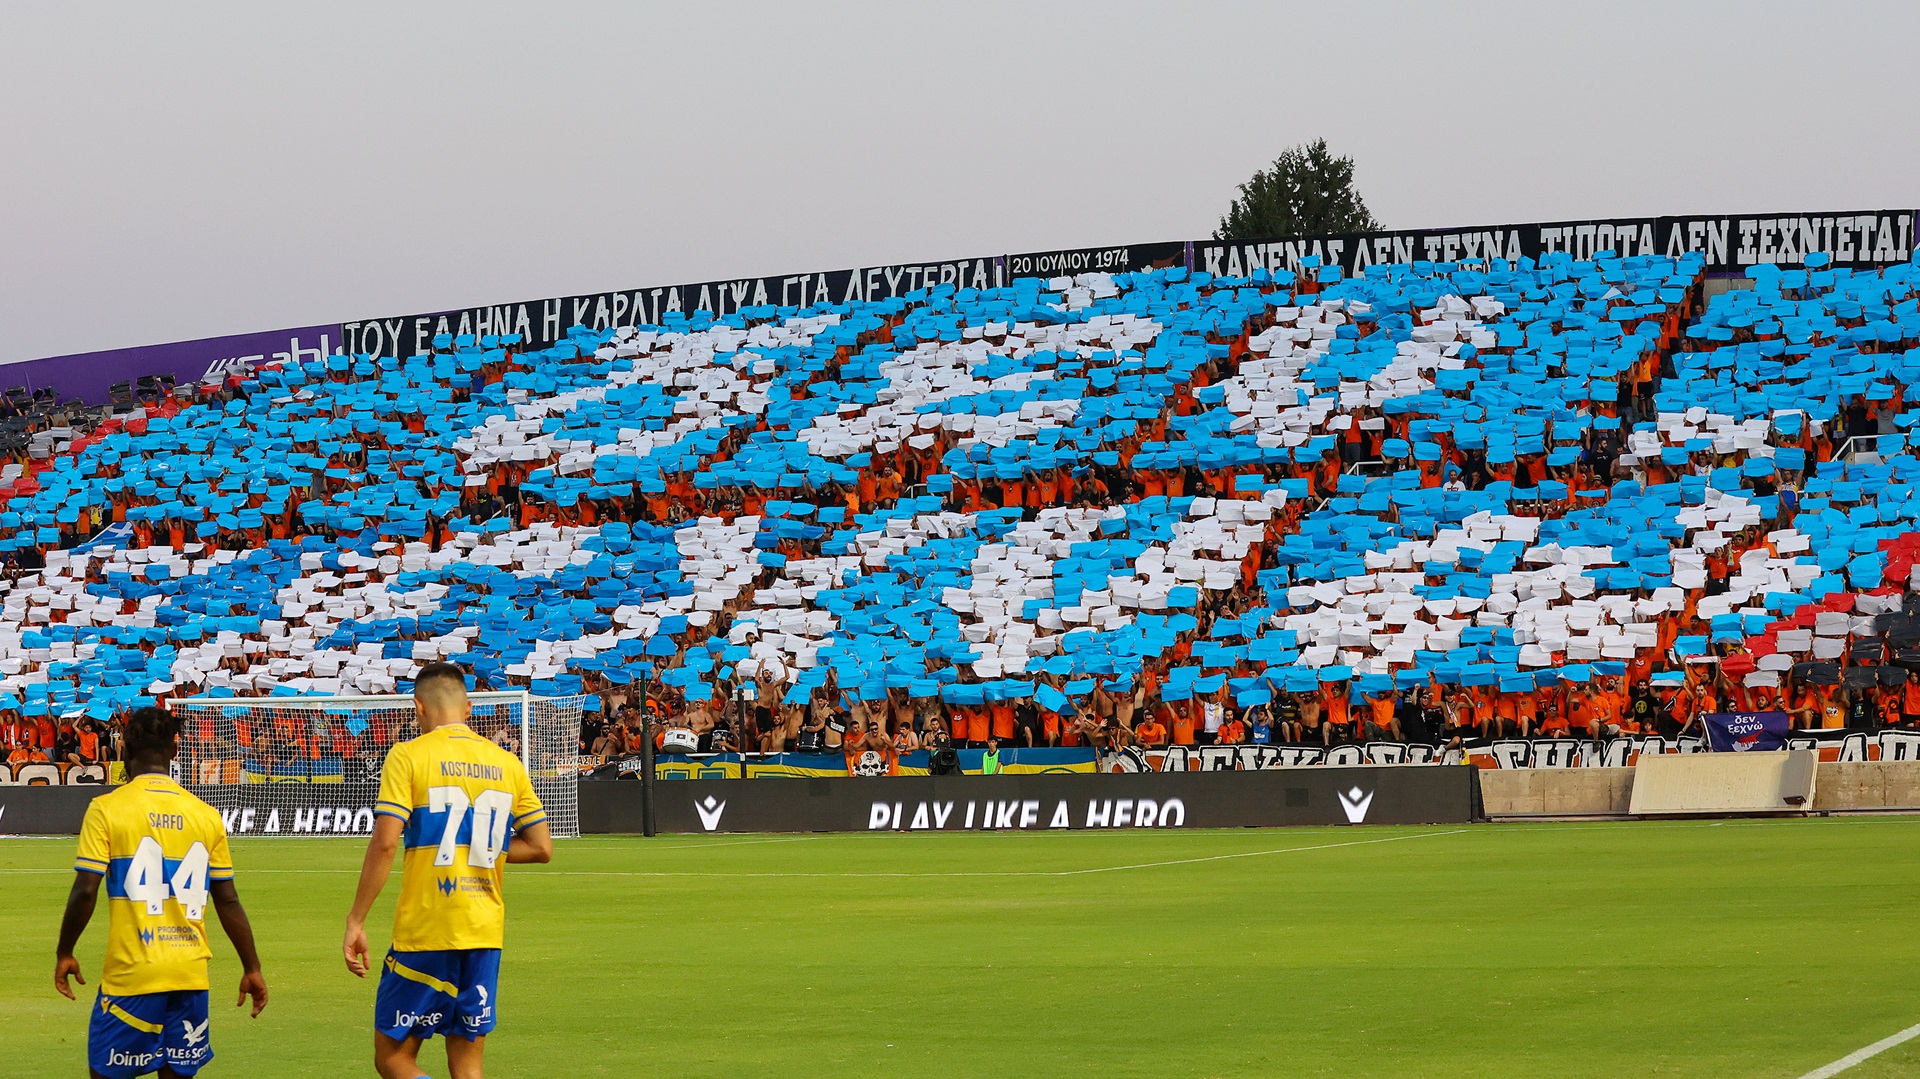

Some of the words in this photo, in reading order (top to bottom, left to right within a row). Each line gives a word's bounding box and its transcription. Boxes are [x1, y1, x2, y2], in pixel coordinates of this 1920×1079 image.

[1540, 224, 1656, 262] ΤΙΠΟΤΑ
[1737, 215, 1911, 265] ΞΕΧΝΙΕΤΑΙ
[1012, 257, 1032, 274] 20
[1036, 253, 1091, 272] ΙΟΥΛΙΟΥ
[1095, 249, 1129, 268] 1974
[345, 319, 403, 363] ΤΟΥ
[543, 298, 562, 342] Η
[782, 273, 829, 311] ΓΙΑ
[1727, 722, 1763, 736] ξεχνώ
[1734, 715, 1756, 724] δεν
[440, 761, 503, 781] KOSTADINOV
[149, 812, 184, 831] SARFO
[868, 801, 954, 829] PLAY
[1049, 800, 1070, 827] A
[1086, 798, 1185, 827] HERO
[428, 786, 514, 868] 70
[124, 836, 209, 920] 44
[166, 1047, 185, 1059] YLE
